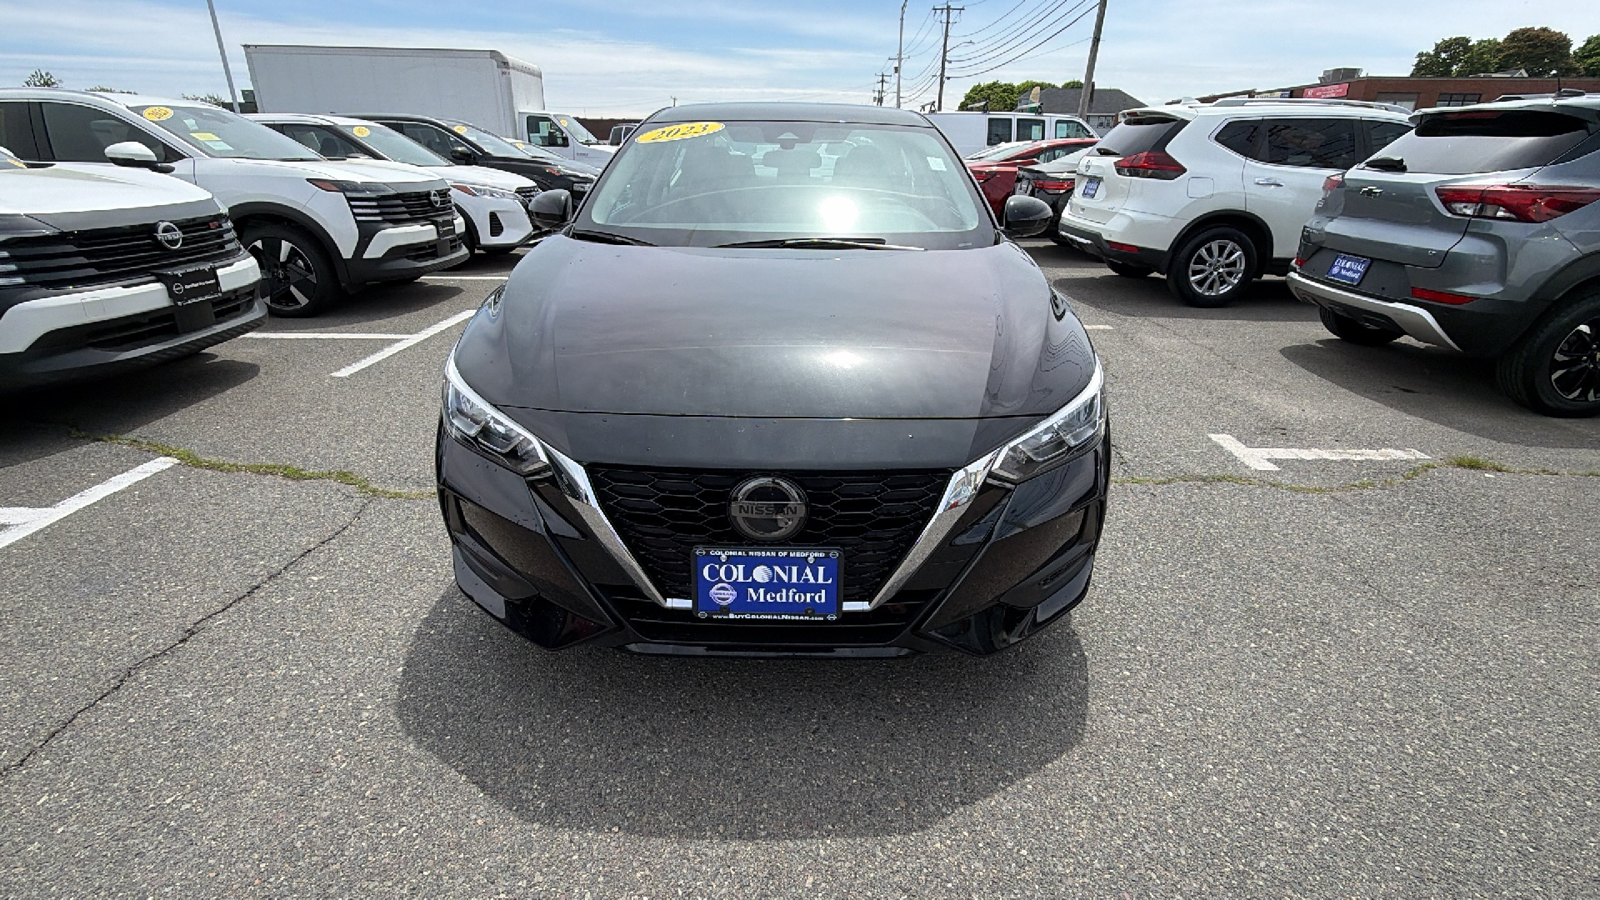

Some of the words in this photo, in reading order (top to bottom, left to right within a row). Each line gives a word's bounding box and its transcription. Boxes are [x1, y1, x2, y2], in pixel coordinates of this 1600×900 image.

[651, 124, 710, 141] 2023
[738, 504, 798, 516] NISSAN
[702, 563, 833, 584] COLONIAL
[746, 587, 827, 604] Medford
